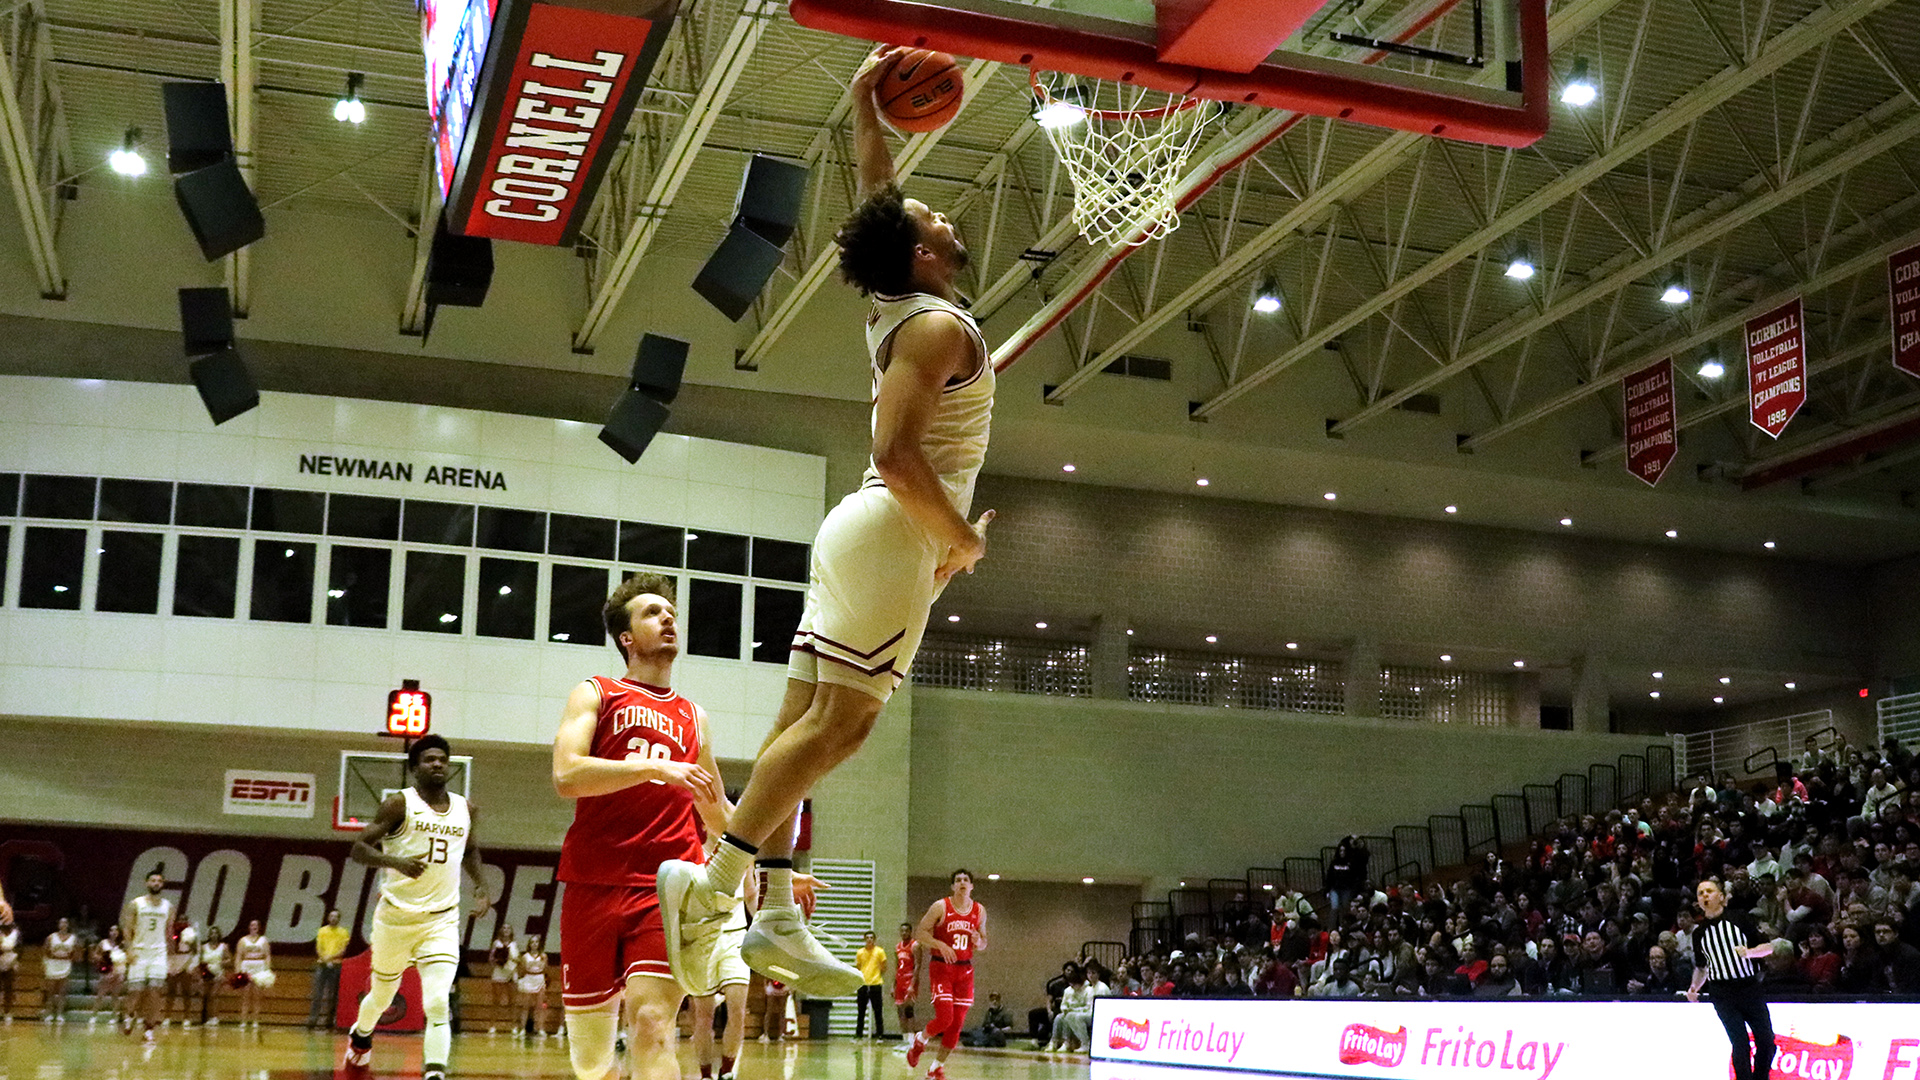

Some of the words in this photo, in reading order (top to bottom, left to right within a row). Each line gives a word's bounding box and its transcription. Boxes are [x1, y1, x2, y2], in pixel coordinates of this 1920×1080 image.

[484, 51, 625, 222] CORNELL
[1750, 314, 1797, 347] CORNELL
[1900, 309, 1916, 326] IVY
[1752, 337, 1798, 366] VOLLEYBALL
[1755, 371, 1767, 385] IVY
[1769, 357, 1798, 379] LEAGUE
[1627, 371, 1669, 401] CORNELL
[1754, 376, 1801, 410] CHAMPIONS
[1628, 392, 1670, 418] VOLLEYBALL
[1767, 408, 1787, 427] 1992
[1630, 421, 1642, 436] IVY
[1643, 411, 1671, 431] LEAGUE
[1630, 429, 1673, 459] CHAMPIONS
[299, 454, 413, 482] NEWMAN
[424, 465, 507, 491] ARENA
[1643, 459, 1661, 475] 1991
[390, 703, 426, 732] 28
[613, 705, 687, 754] CORNELL
[230, 778, 310, 802] ESPN
[415, 820, 464, 837] HARVARD
[427, 837, 449, 864] 13
[118, 846, 253, 943] GO
[459, 863, 566, 953] RE
[947, 920, 975, 932] CORNEL
[952, 933, 969, 951] 30
